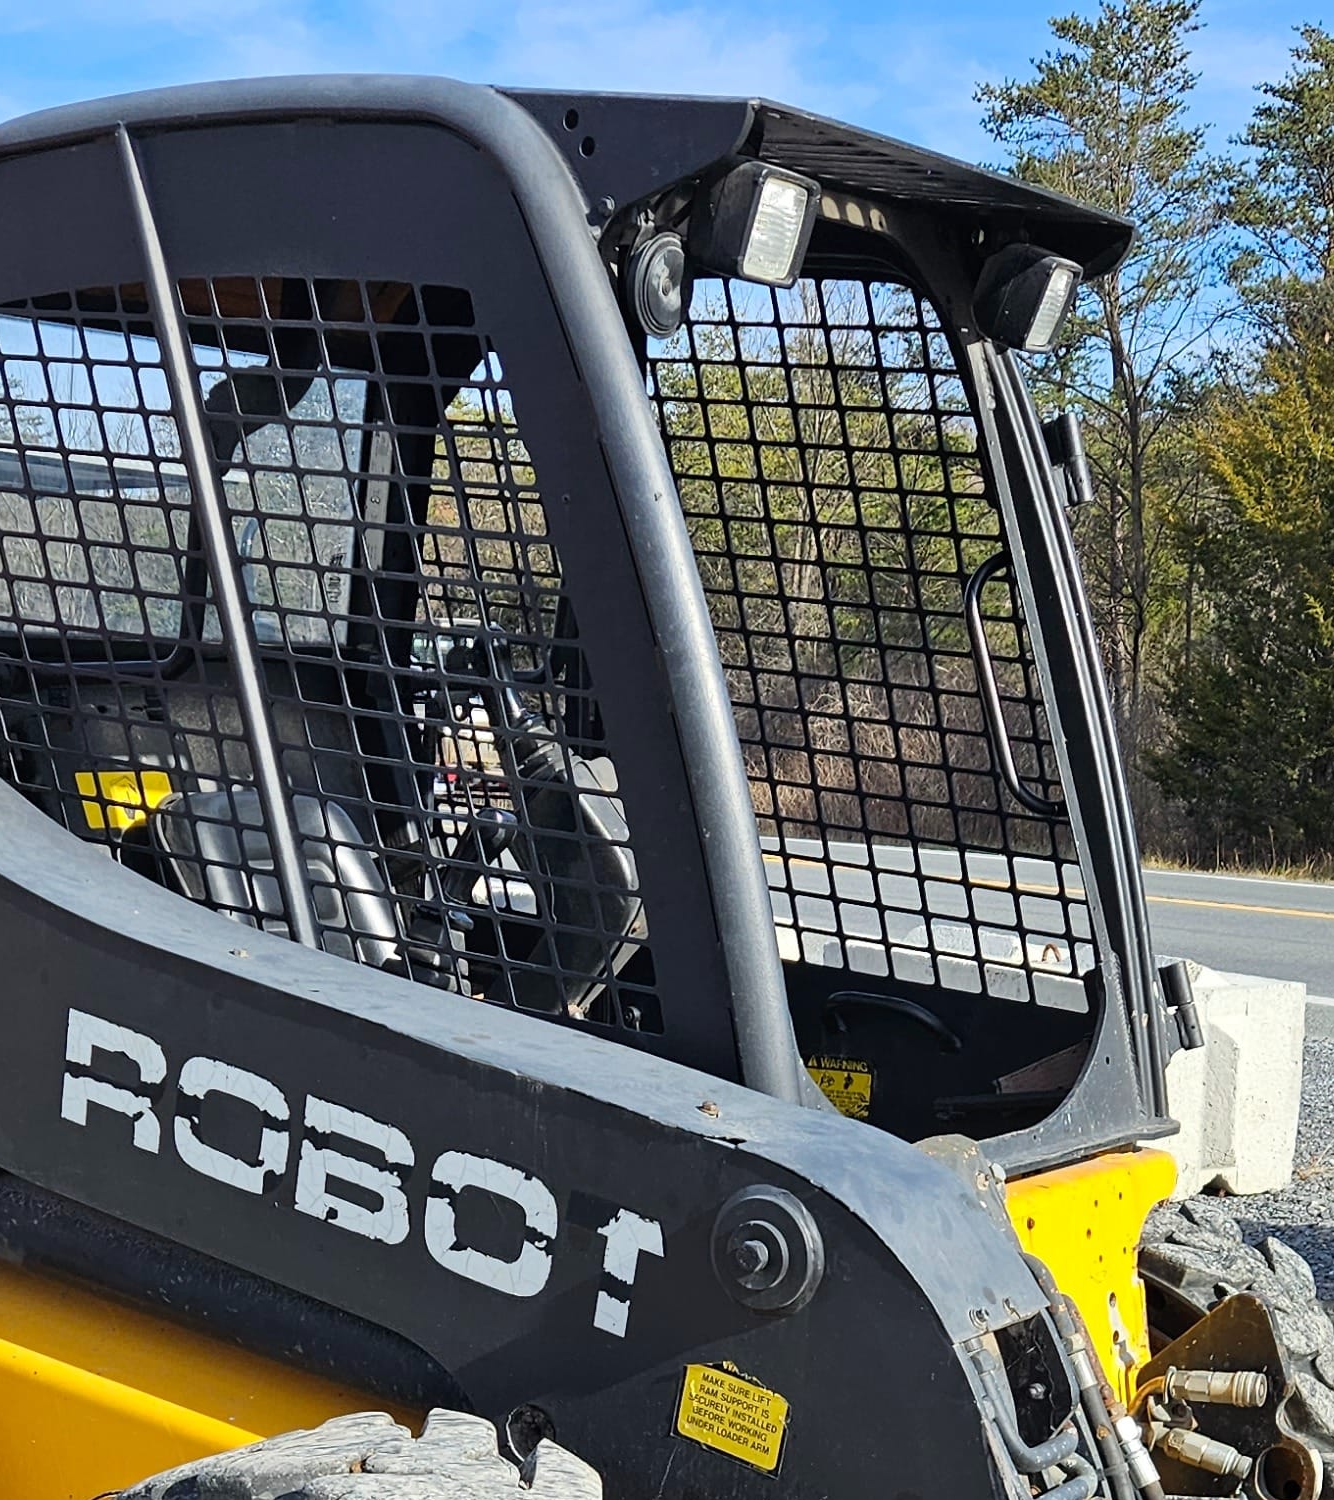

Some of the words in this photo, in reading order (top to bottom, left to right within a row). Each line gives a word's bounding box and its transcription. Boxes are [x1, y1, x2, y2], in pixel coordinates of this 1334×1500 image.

[61, 1007, 665, 1338] ROBOT
[699, 1384, 718, 1398] RAM
[721, 1393, 759, 1414] SUPPORT
[761, 1409, 769, 1419] IS
[703, 1373, 725, 1389] MAKE
[728, 1383, 751, 1399] SURE
[752, 1393, 771, 1406] LIFT
[689, 1392, 730, 1414] SECURELY
[733, 1410, 777, 1433] INSTALLED
[692, 1406, 725, 1423] BEFORE
[729, 1419, 767, 1441] WORKING
[687, 1416, 714, 1431] UNDER
[717, 1426, 748, 1446] LOADER
[751, 1442, 769, 1455] ARM
